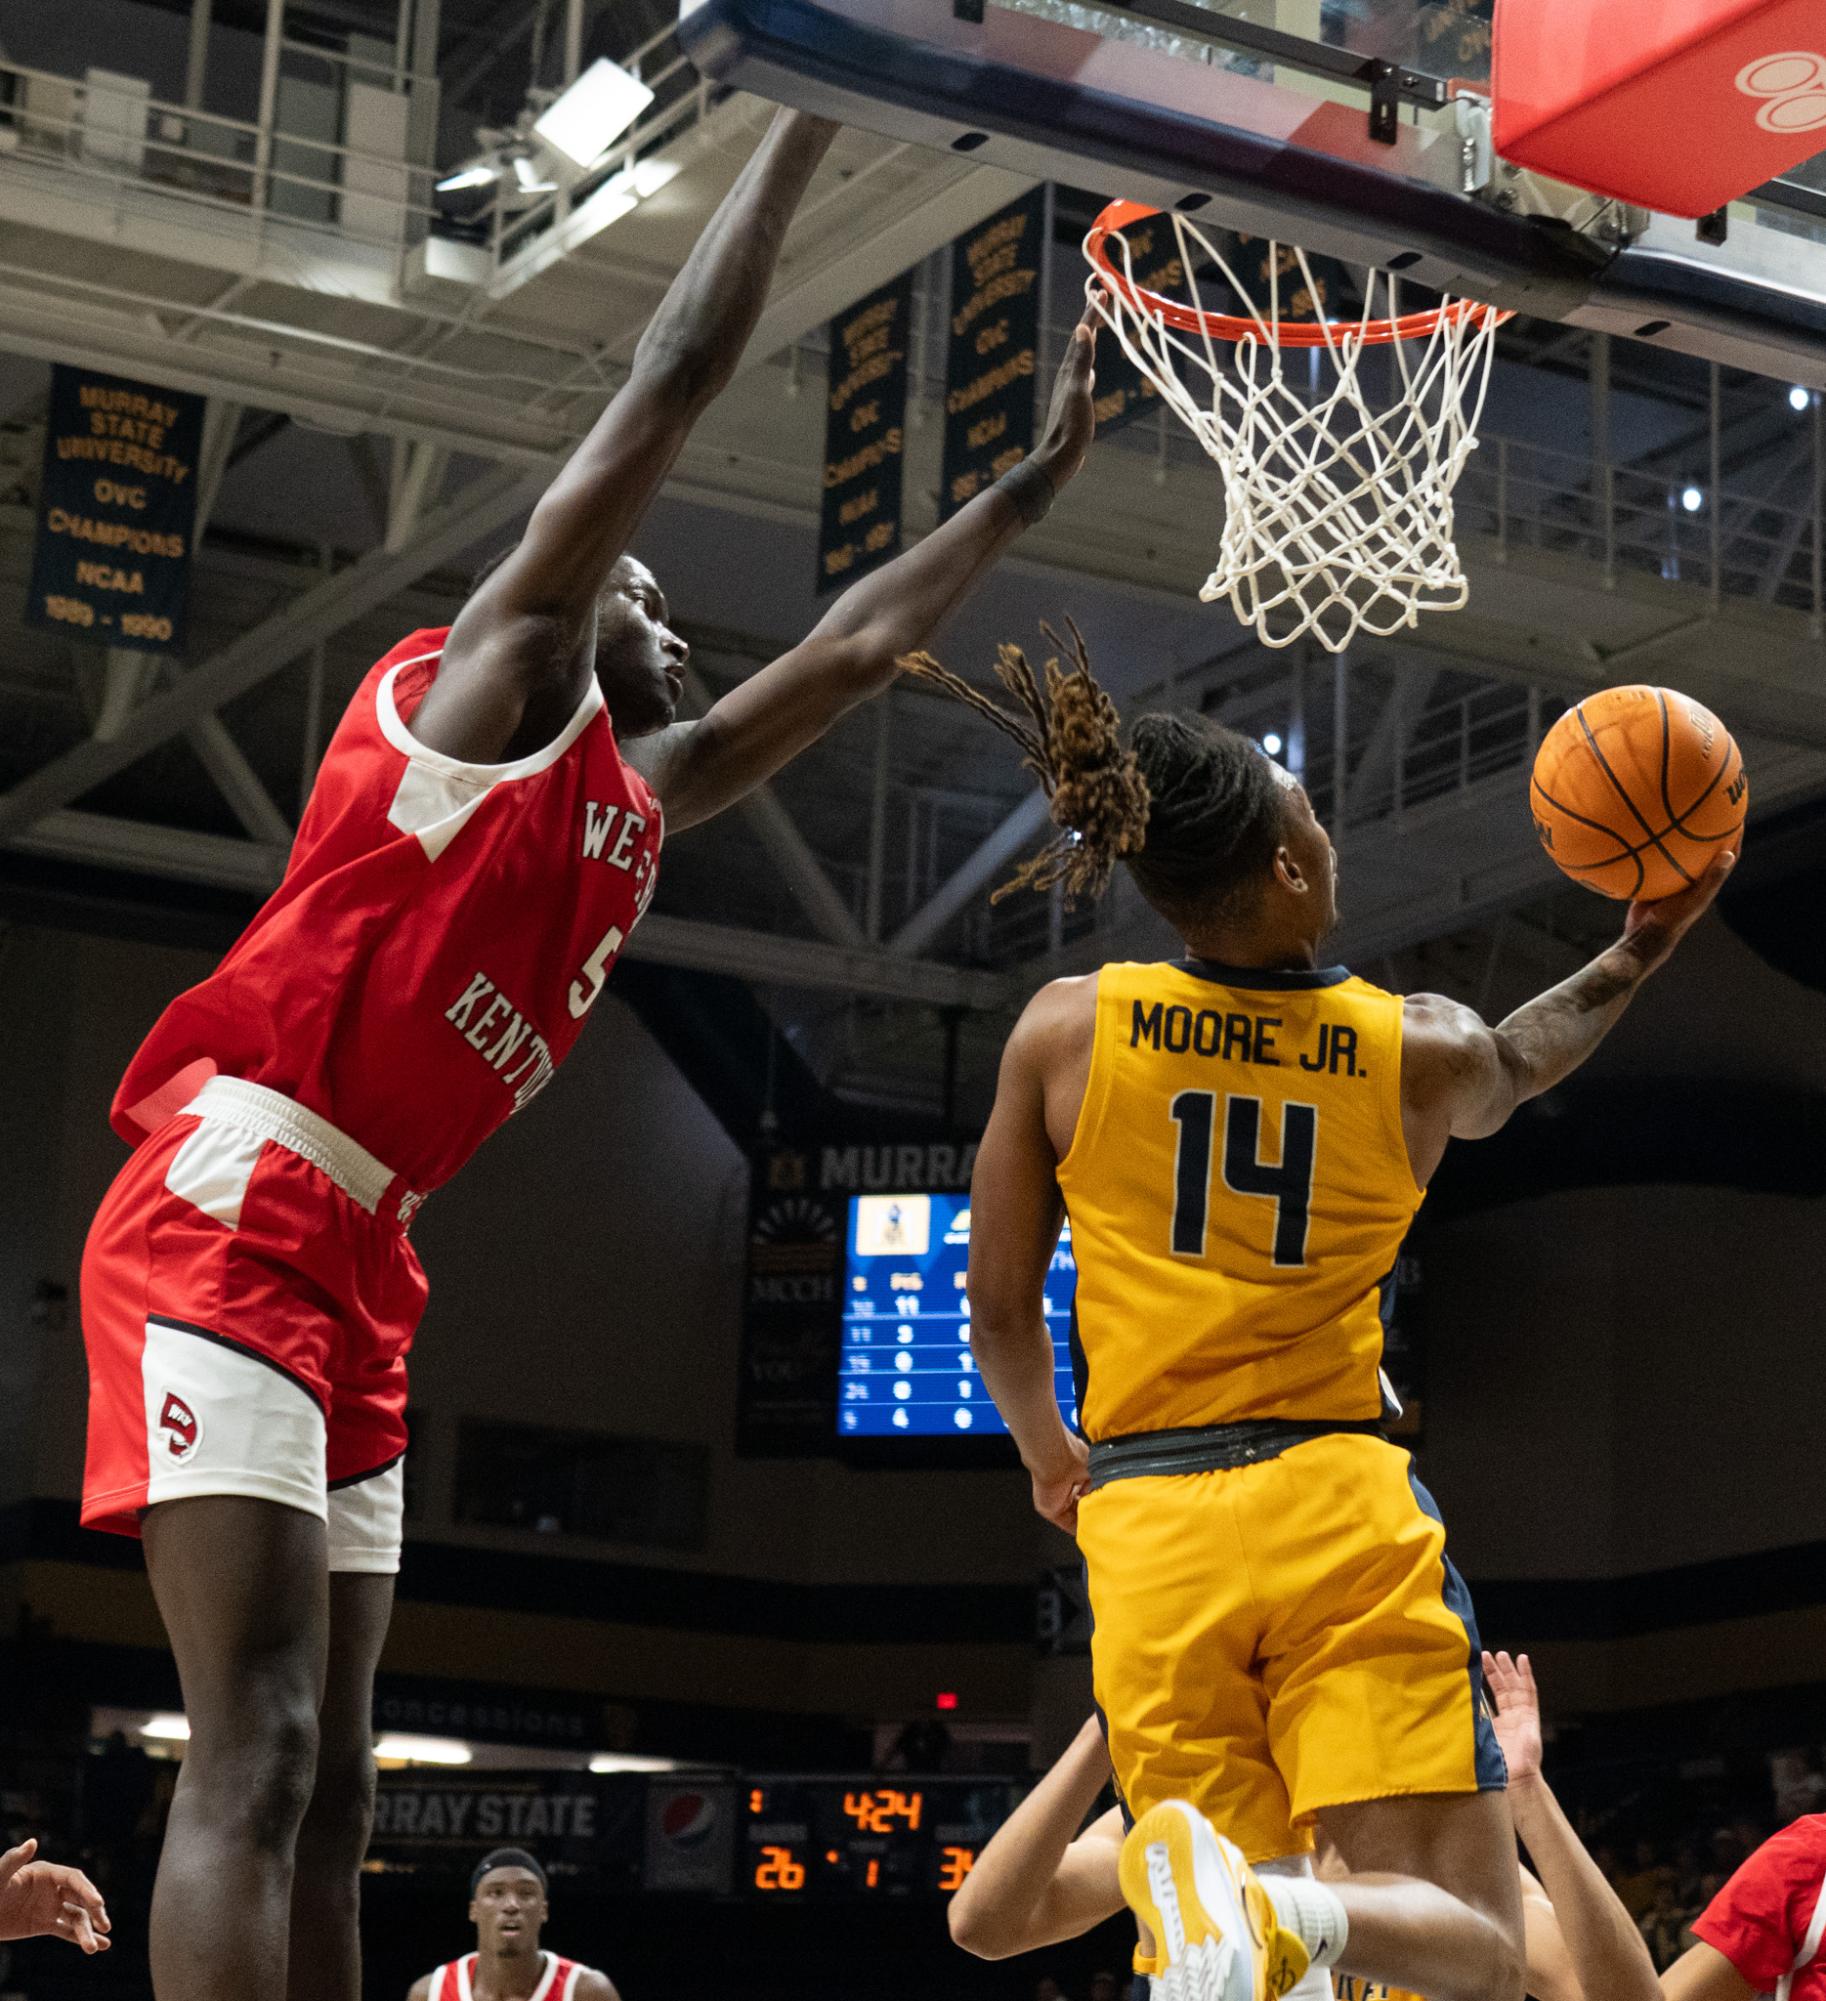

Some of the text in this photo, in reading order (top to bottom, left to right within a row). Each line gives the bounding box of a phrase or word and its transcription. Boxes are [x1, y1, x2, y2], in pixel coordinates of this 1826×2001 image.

[80, 385, 178, 427] MURRAY
[90, 411, 164, 449] STATE
[57, 436, 190, 484] UNIVERSITY
[94, 479, 147, 510] OVC
[48, 506, 185, 558] CHAMPIONS
[75, 560, 144, 595] NCAA
[568, 925, 624, 1019] 5
[1130, 999, 1367, 1078] MOORE JR.
[822, 1144, 973, 1188] MURRA
[1169, 1088, 1318, 1268] 14
[383, 1697, 583, 1738] oncessions
[475, 1794, 596, 1838] STATE
[753, 1843, 806, 1892] 26
